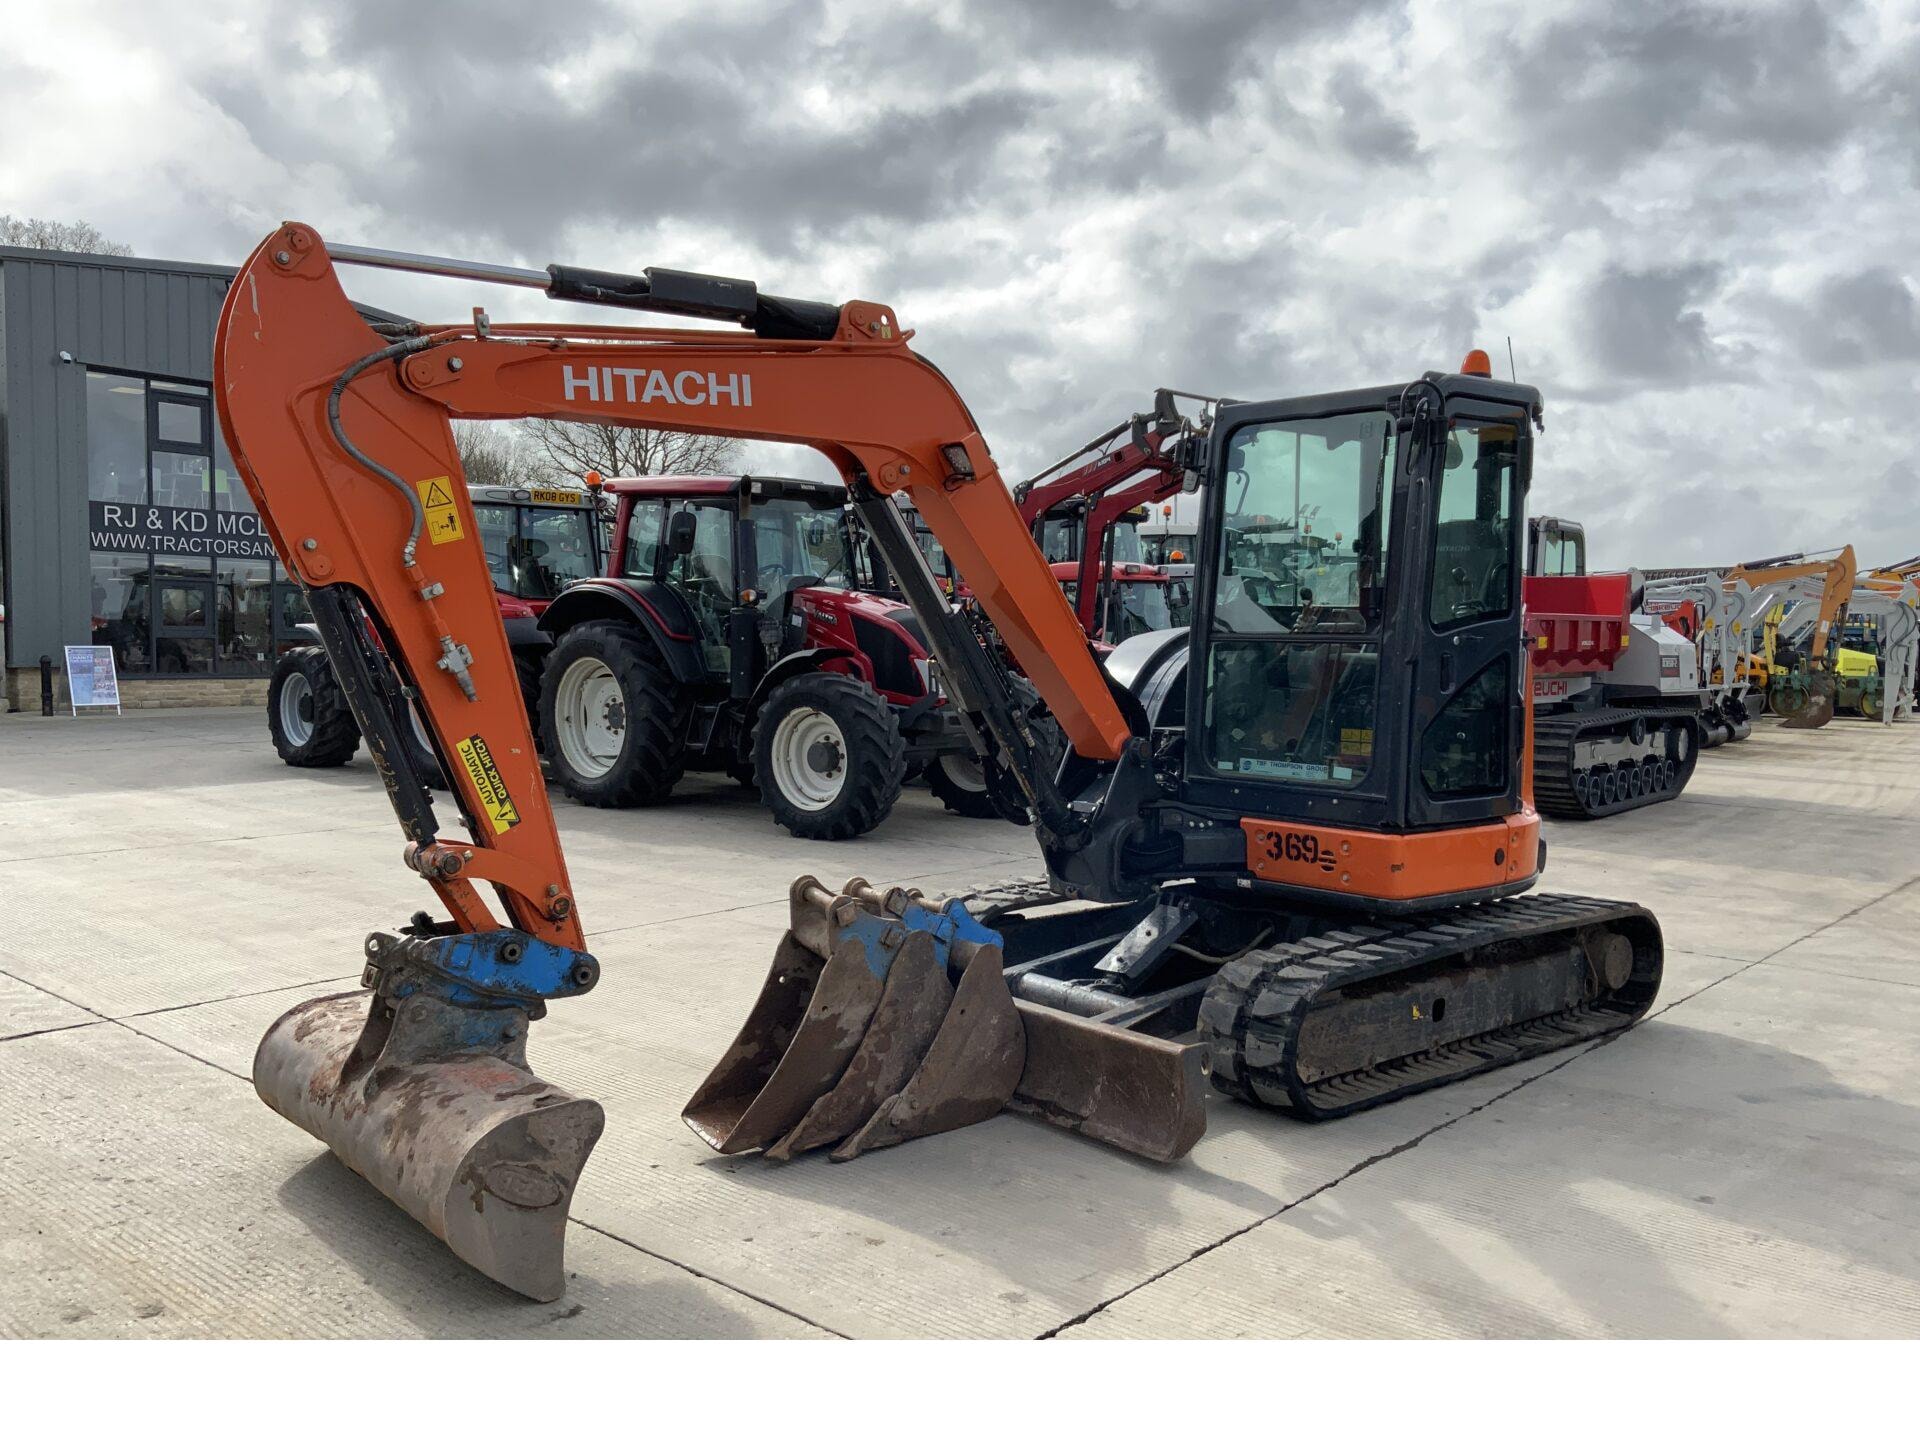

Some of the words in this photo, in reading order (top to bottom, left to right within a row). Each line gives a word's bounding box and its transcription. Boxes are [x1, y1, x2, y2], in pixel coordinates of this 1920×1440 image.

[563, 365, 752, 407] HITACHI
[534, 490, 557, 502] RK08
[559, 492, 576, 503] GYS
[104, 505, 137, 528] RJ
[146, 508, 163, 530] &
[172, 510, 208, 532] KD
[91, 531, 279, 557] WWW.TRACTORSAN
[474, 738, 493, 768] HITCH
[1306, 764, 1328, 772] GROUP
[461, 744, 495, 805] AUTOMATIC
[487, 767, 507, 799] QUICK
[1265, 831, 1319, 864] 369
